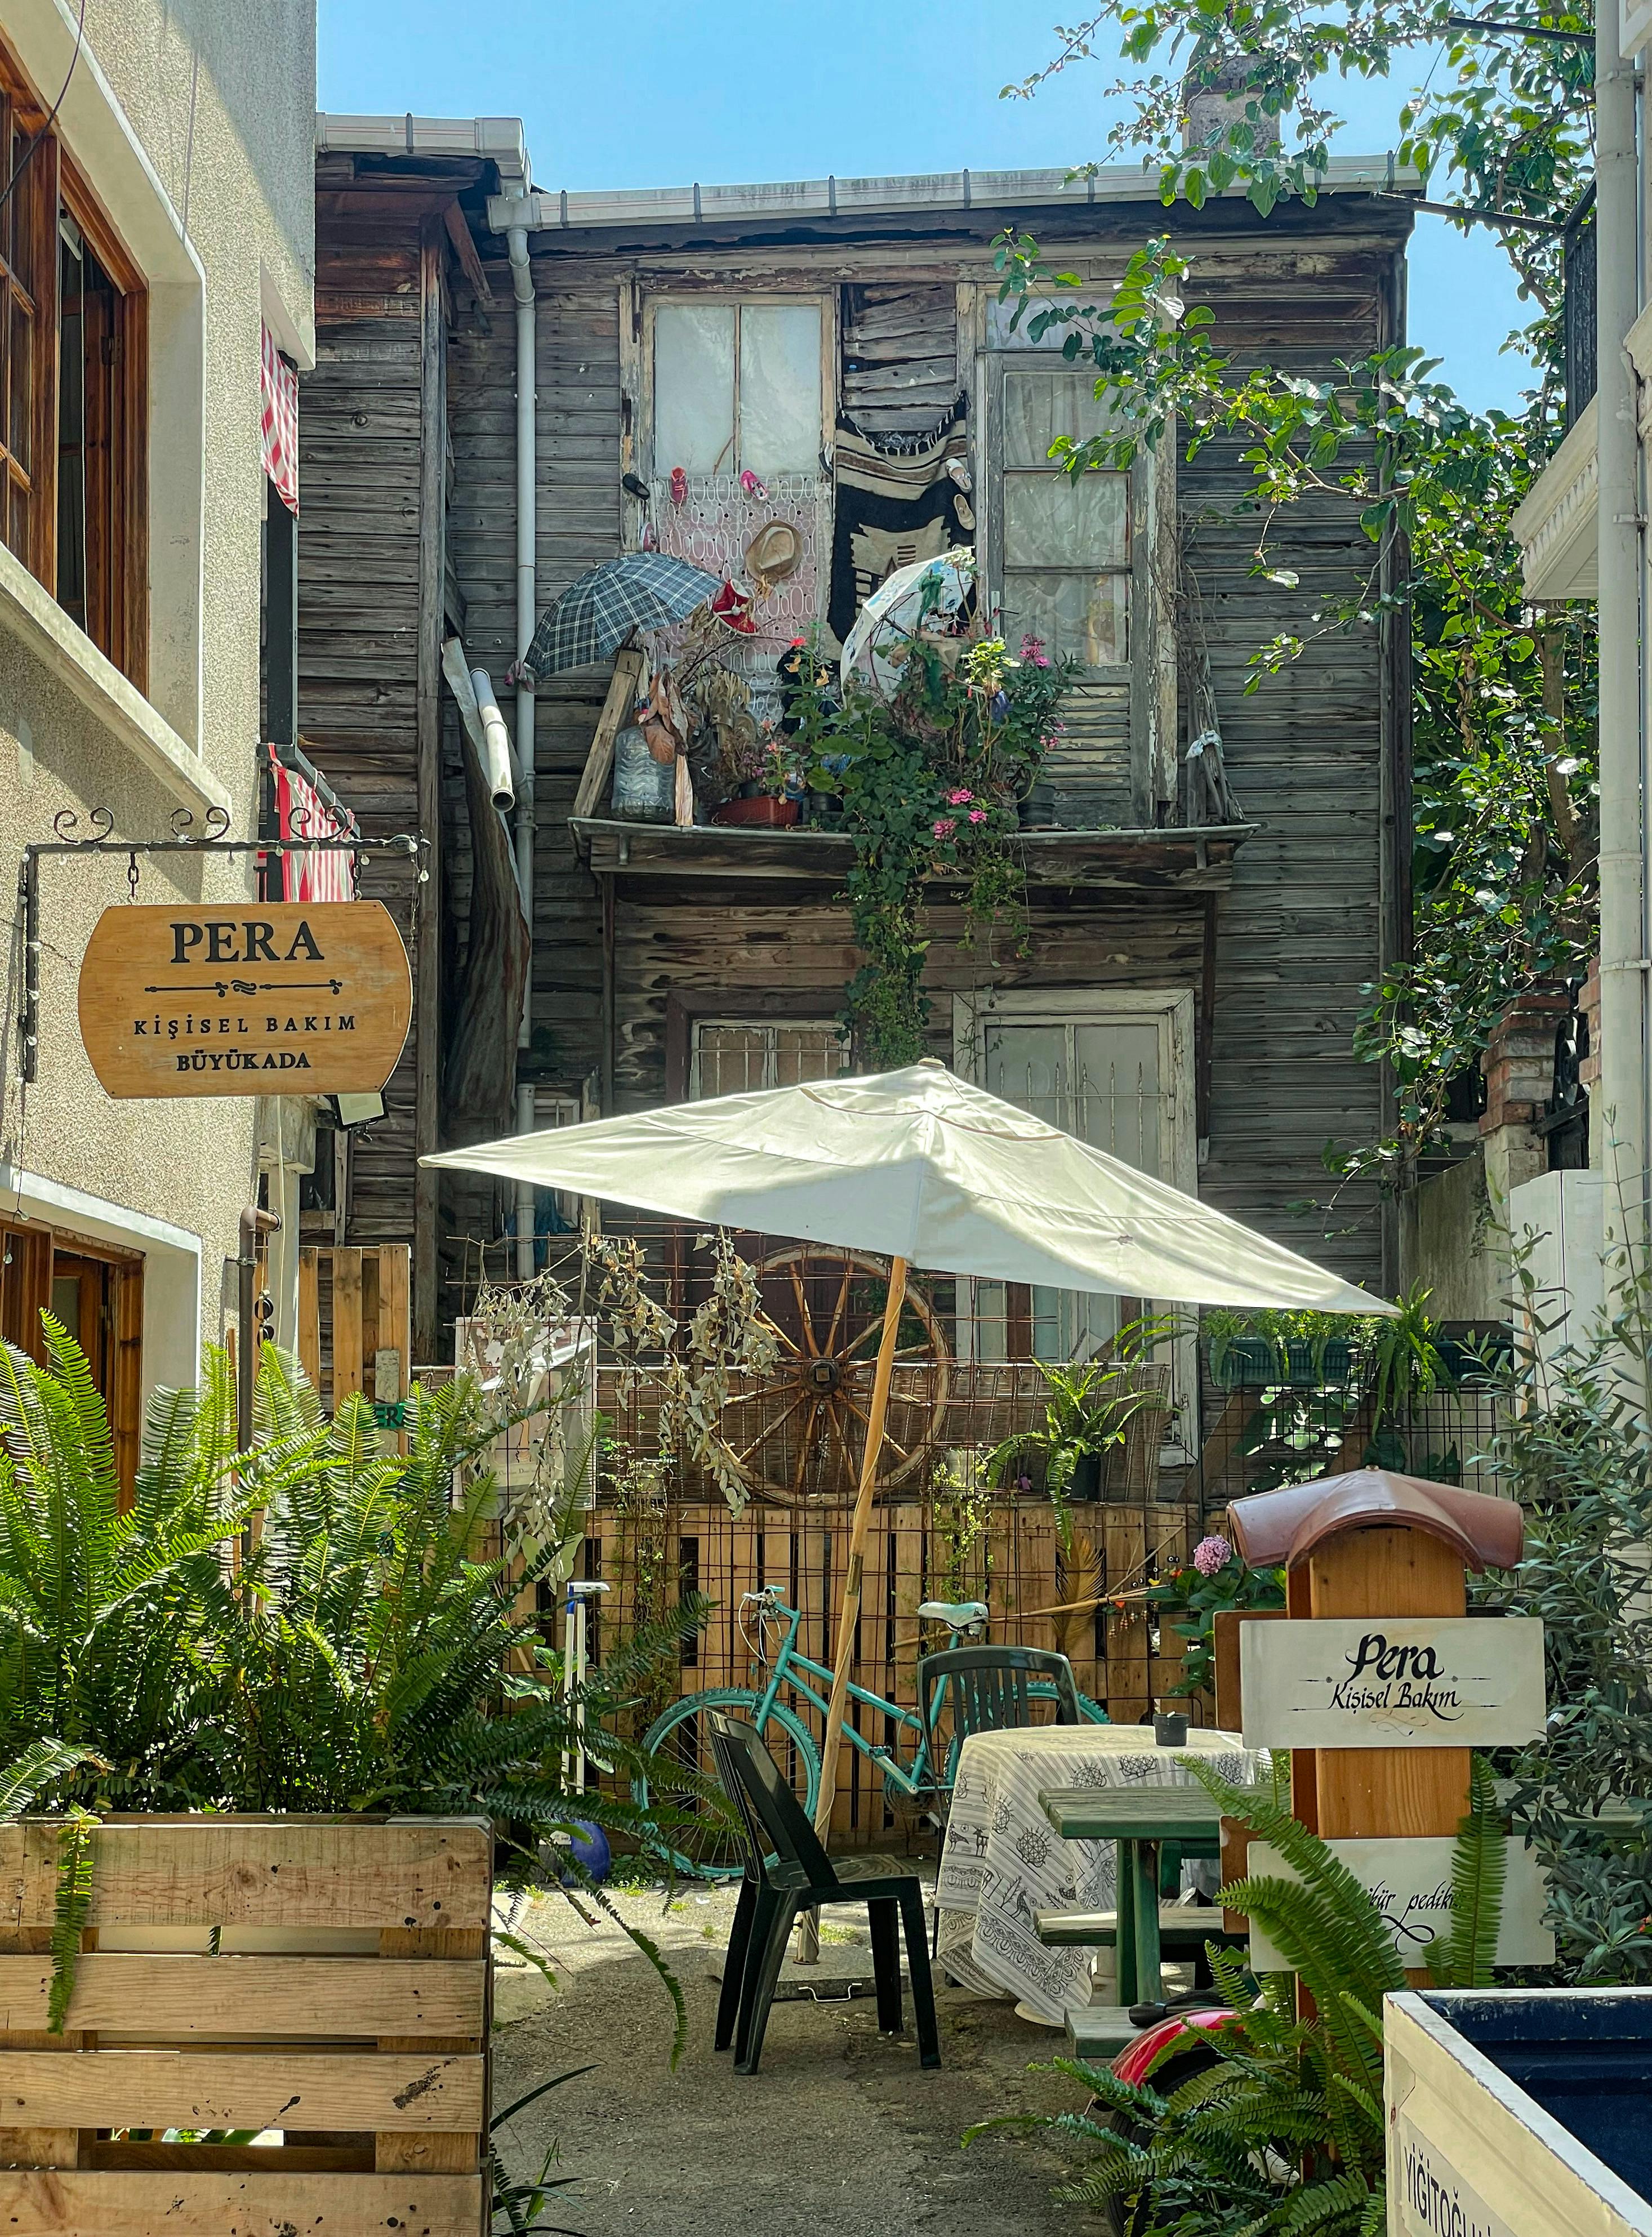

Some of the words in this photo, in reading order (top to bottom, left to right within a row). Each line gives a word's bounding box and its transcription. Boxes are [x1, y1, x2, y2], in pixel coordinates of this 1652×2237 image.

[170, 921, 325, 963] PERA
[133, 1014, 248, 1040] KİŞİSEL
[266, 1015, 355, 1032] BAKIM
[176, 1049, 311, 1071] BÜYÜKADA
[1344, 1633, 1445, 1684] Pera
[1328, 1682, 1392, 1714] Kişisel
[1392, 1681, 1464, 1721] Bakım
